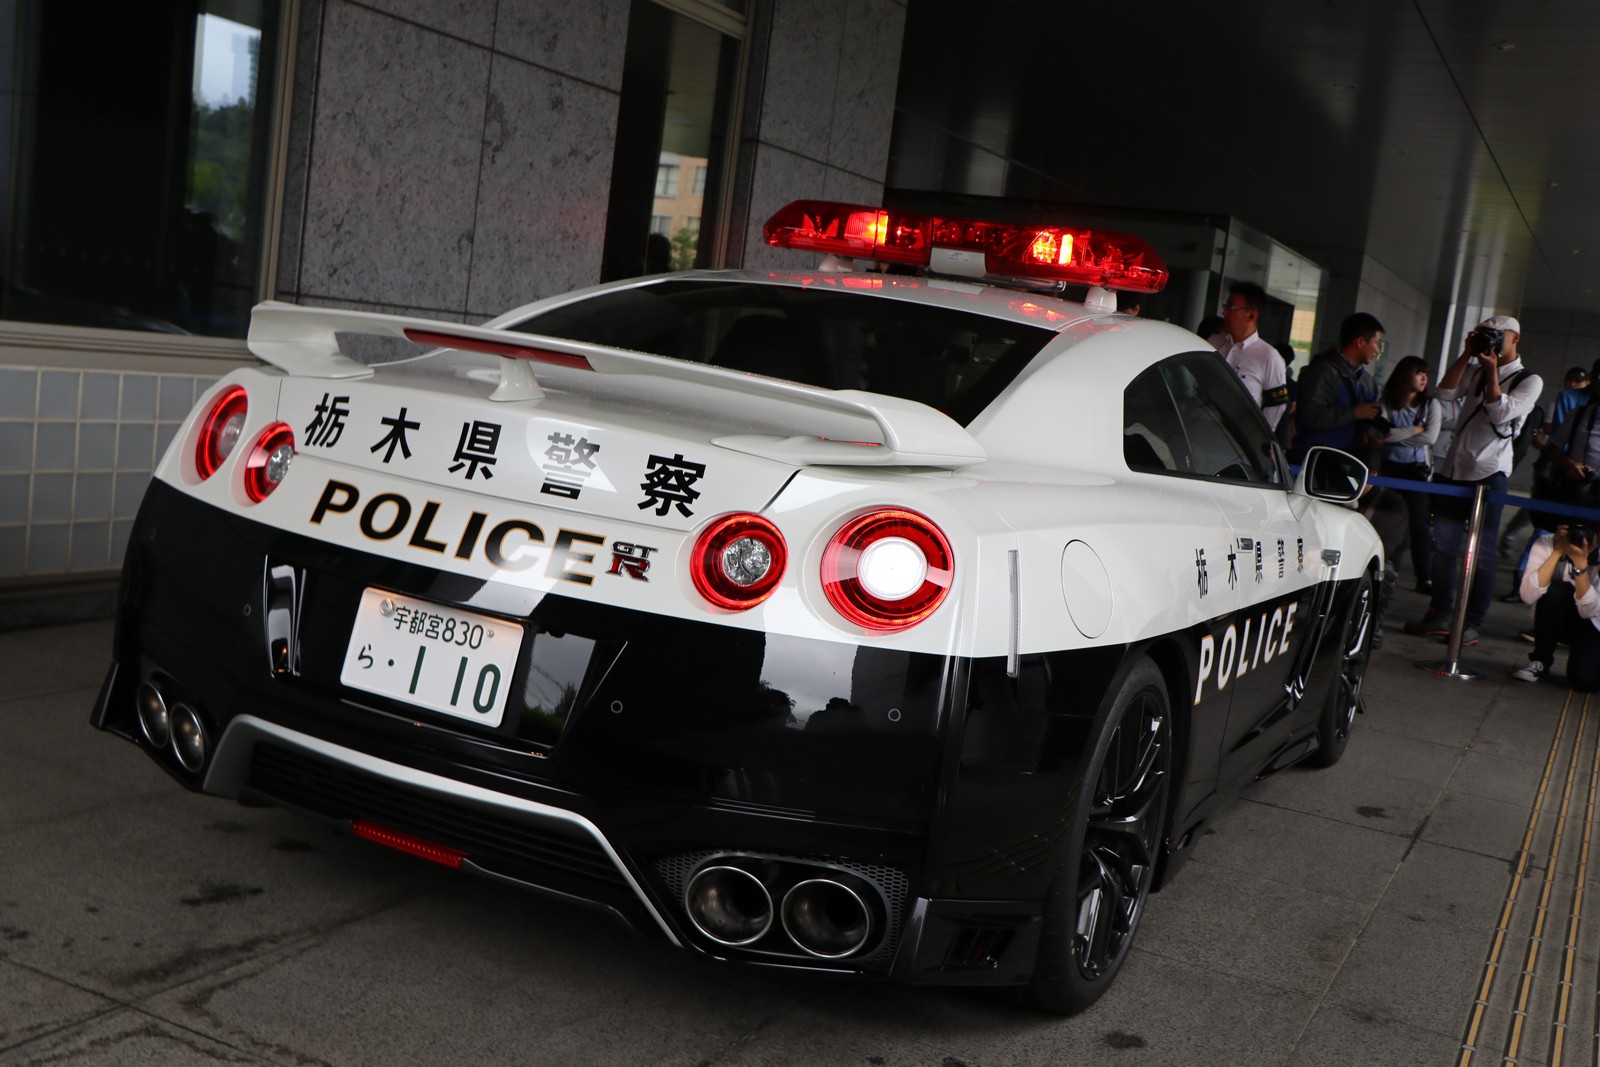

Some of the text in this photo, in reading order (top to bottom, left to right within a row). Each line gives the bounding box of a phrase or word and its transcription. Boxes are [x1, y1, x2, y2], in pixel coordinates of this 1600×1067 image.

[304, 392, 706, 518] 栃木県警察
[309, 478, 607, 587] POLICE
[1194, 601, 1298, 706] POLICE
